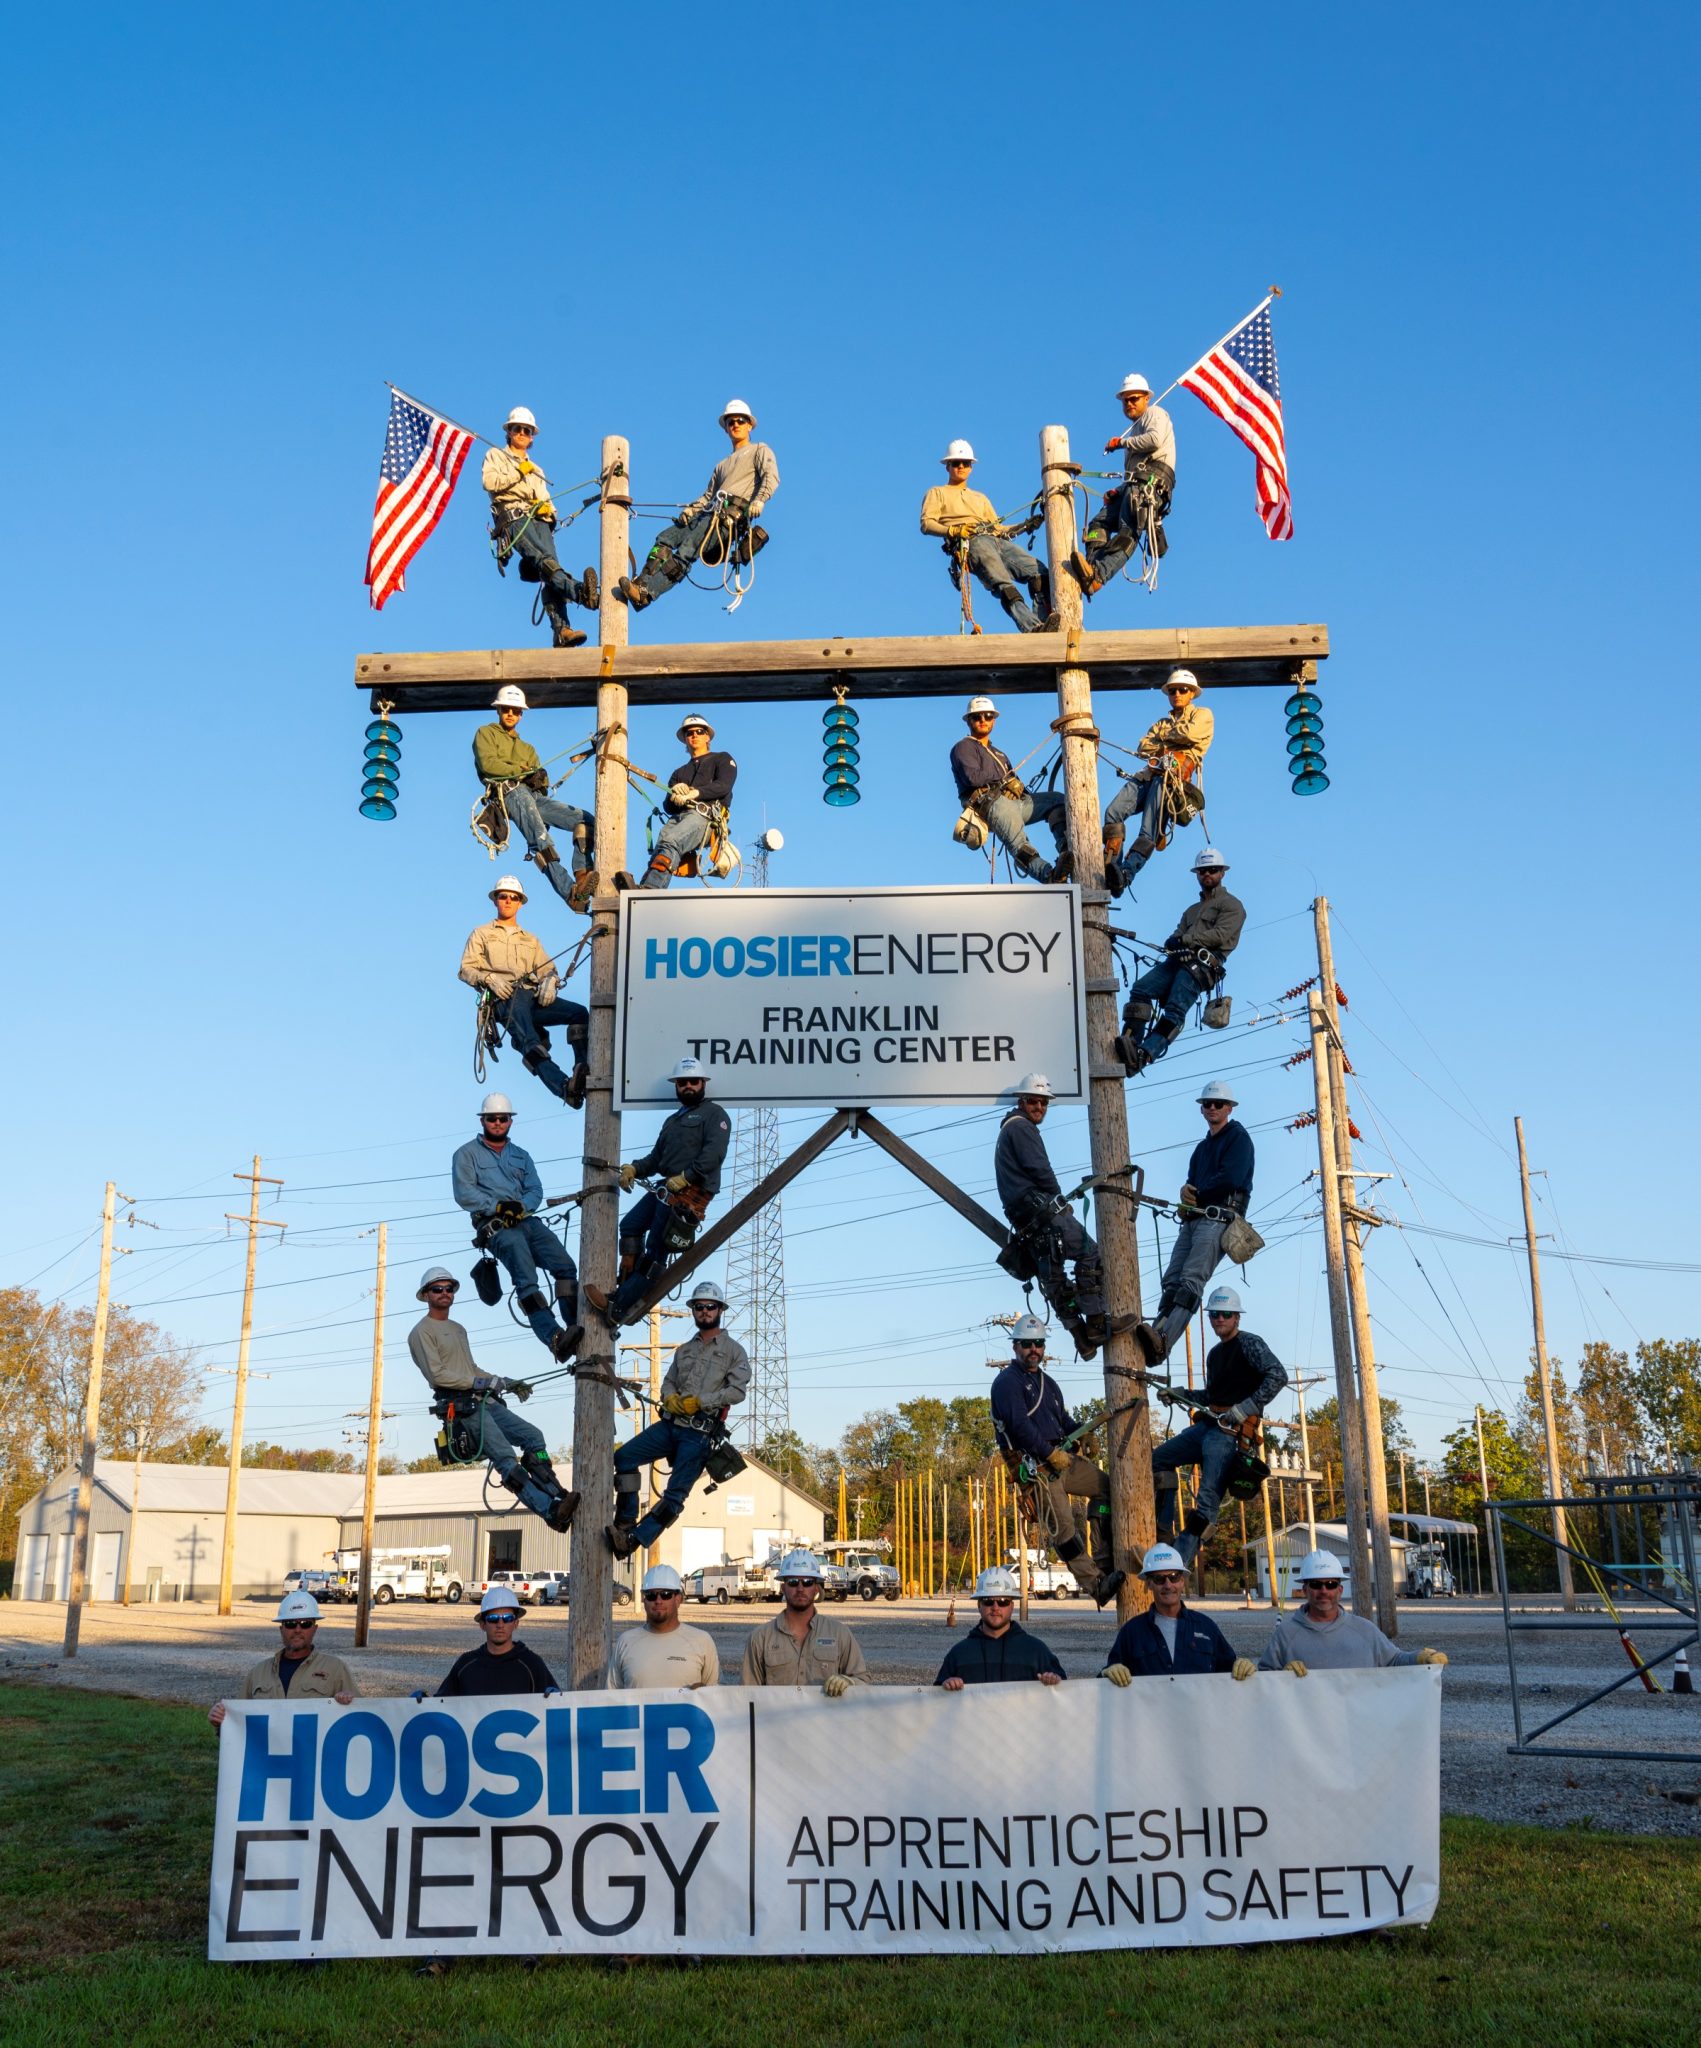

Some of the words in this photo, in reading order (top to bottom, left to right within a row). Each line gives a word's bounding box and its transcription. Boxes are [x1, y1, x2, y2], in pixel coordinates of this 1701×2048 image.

[686, 1038, 861, 1065] TRAINING
[873, 1036, 1016, 1064] CENTER
[762, 1004, 939, 1033] FRANKLIN
[237, 1703, 720, 1822] HOOSIER
[786, 1806, 1269, 1869] APPRENTICESHIP
[225, 1821, 720, 1943] ENERGY
[786, 1878, 1052, 1932] TRAINING
[1066, 1871, 1187, 1929] AND
[1202, 1864, 1414, 1922] SAFETY
